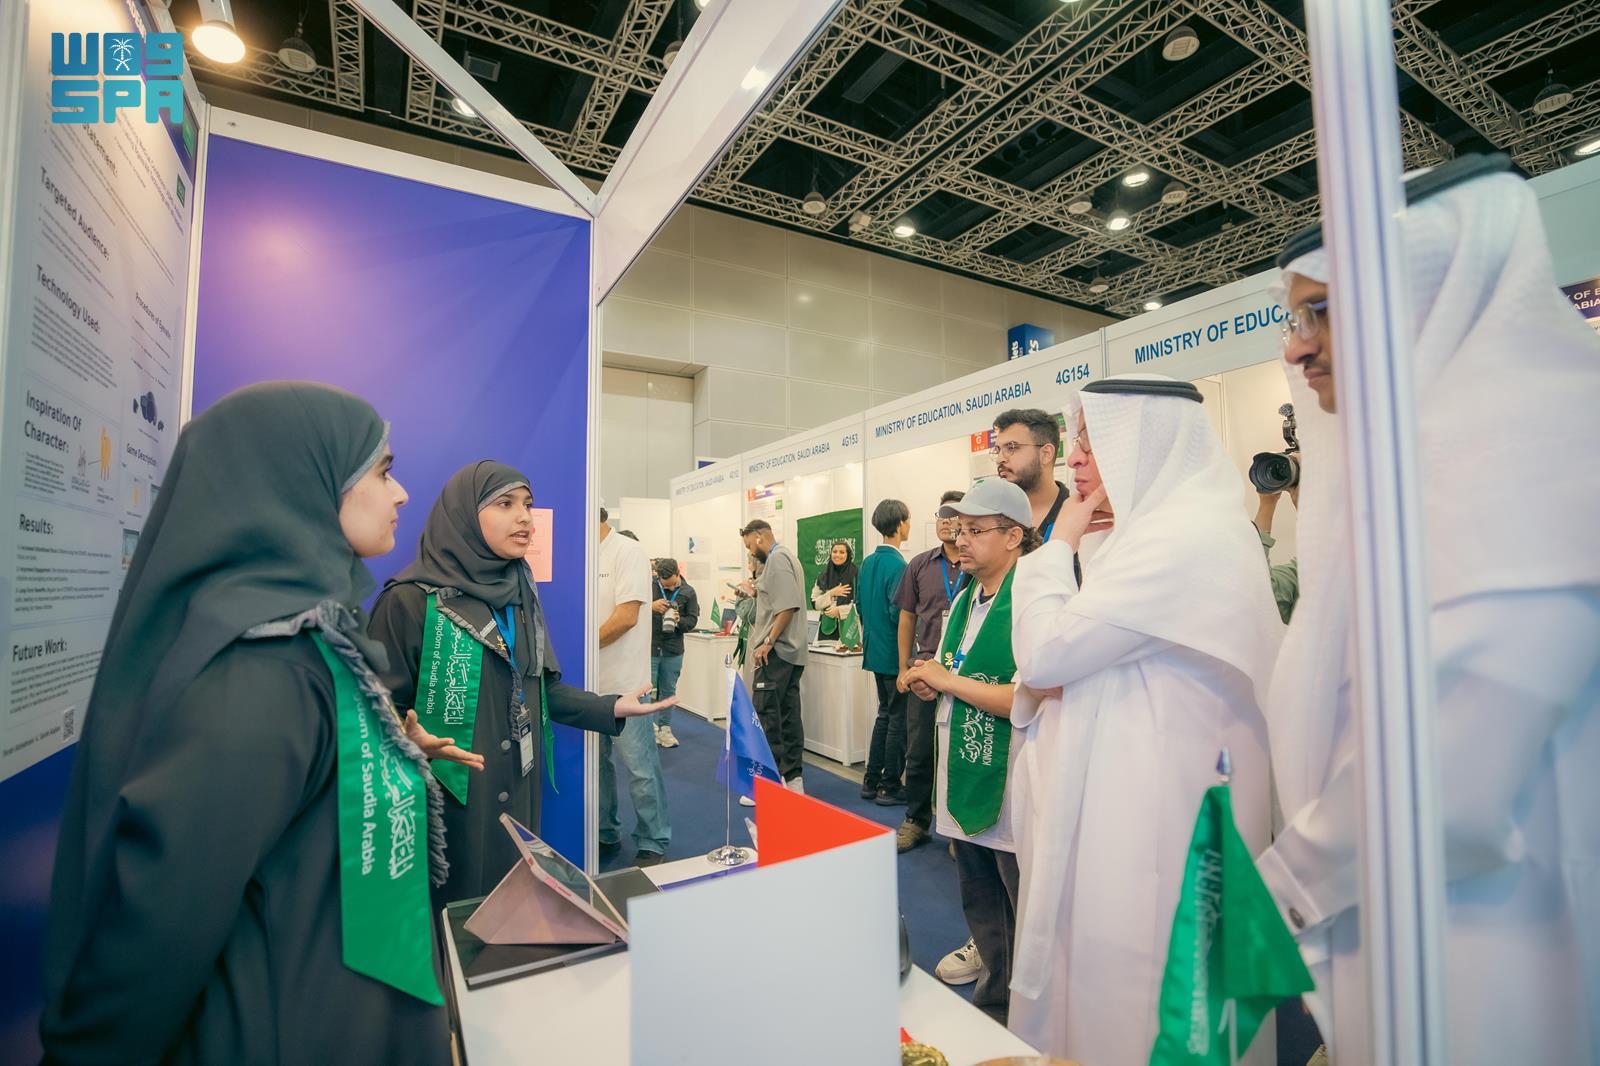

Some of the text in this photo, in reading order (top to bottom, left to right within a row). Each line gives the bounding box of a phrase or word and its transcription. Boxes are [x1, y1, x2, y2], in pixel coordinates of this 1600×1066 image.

[40, 165, 78, 222] Targeted
[78, 211, 110, 260] Audience:
[36, 264, 101, 334] Technology Used:
[1574, 290, 1591, 300] OF
[1135, 304, 1291, 364] MINISTRY OF EDUC
[26, 390, 82, 433] Inspiration Of
[875, 363, 1090, 438] MINISTRY OF EDUCATION, SAUDI ARABIA 4G154
[24, 420, 70, 454] Character:
[812, 442, 830, 458] ARABIA
[842, 433, 859, 447] 4G153
[19, 513, 54, 535] Results:
[12, 637, 67, 663] Future Work:
[433, 651, 441, 659] of
[430, 660, 441, 687] Saudia
[426, 688, 436, 715] Arabia
[984, 722, 995, 732] OF
[360, 741, 373, 759] of
[982, 733, 994, 766] KINGDOM
[362, 762, 377, 818] Saudia
[362, 821, 377, 876] Arabia
